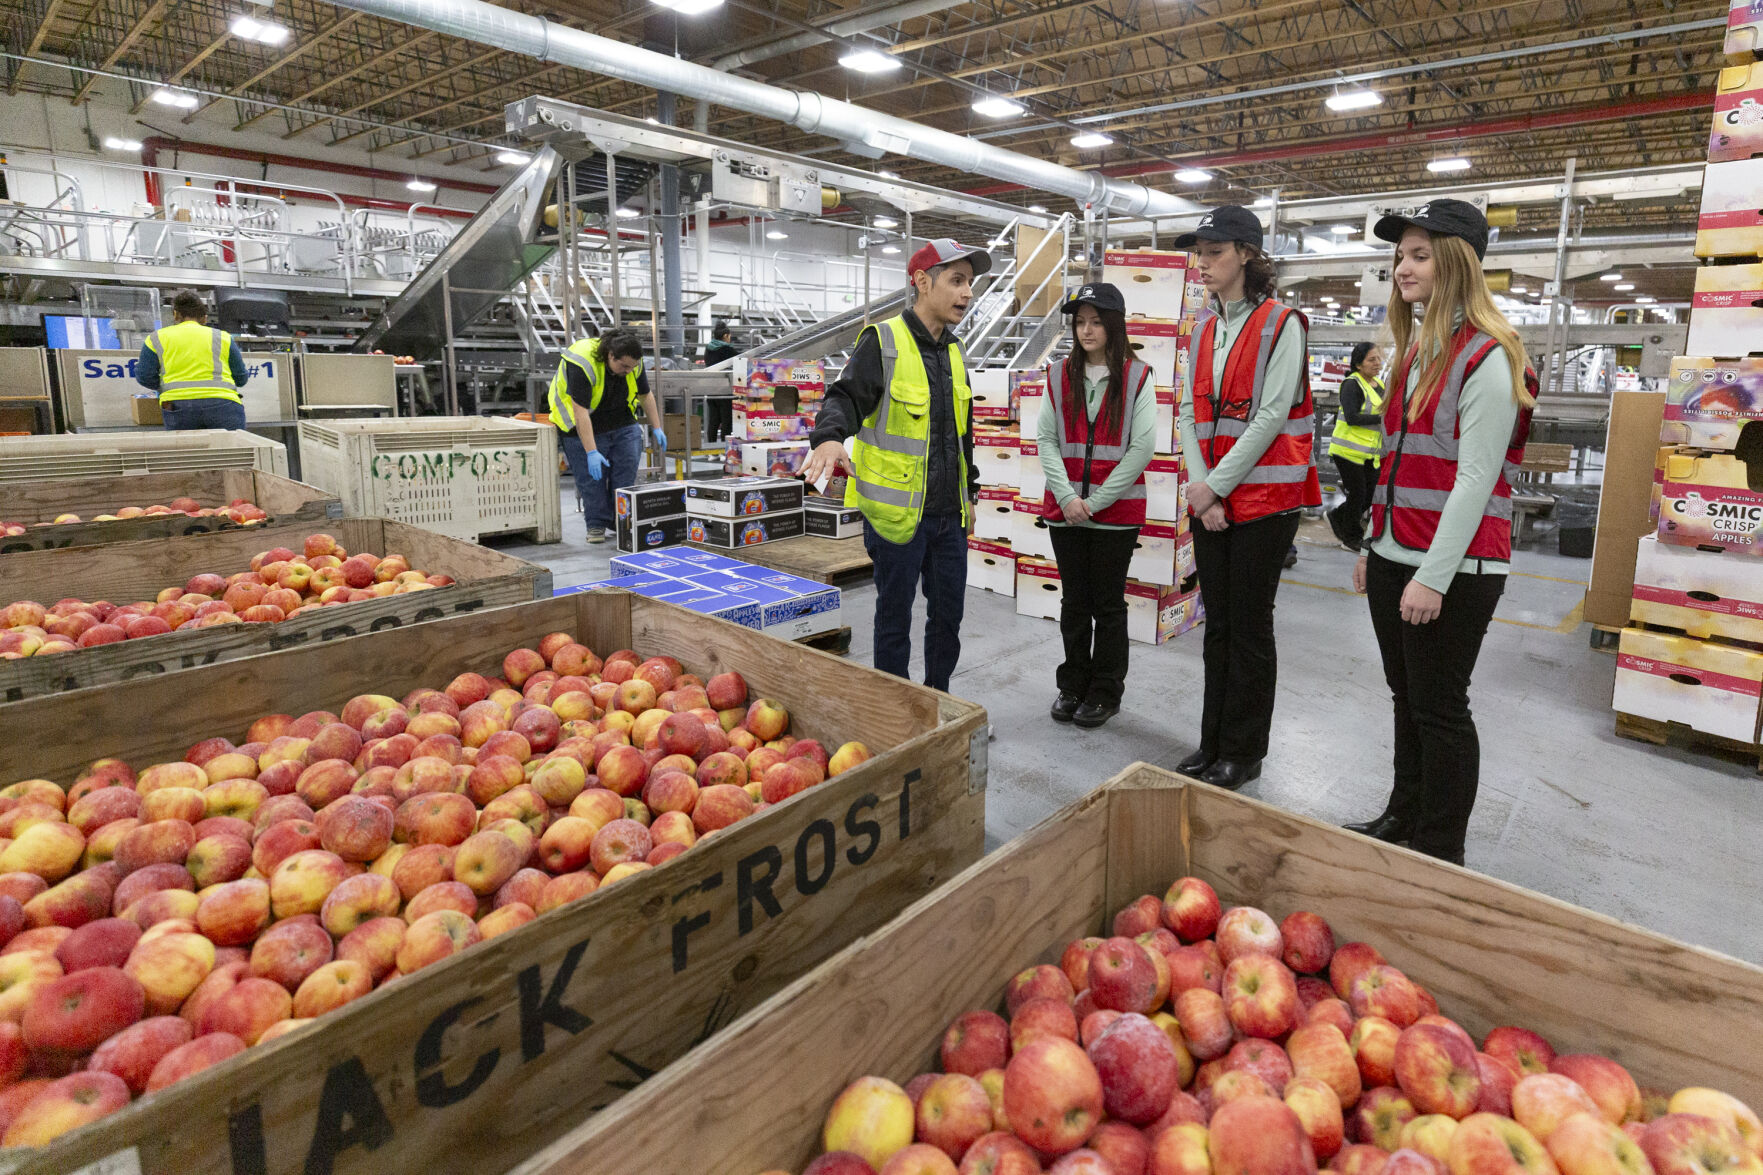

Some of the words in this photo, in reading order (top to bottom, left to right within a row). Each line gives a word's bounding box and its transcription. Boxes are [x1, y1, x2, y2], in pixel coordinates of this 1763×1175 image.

[1702, 293, 1734, 302] COSMIC
[371, 450, 536, 480] COMPOST
[1721, 494, 1756, 503] AMAZING
[1673, 499, 1762, 521] COSMIC
[1713, 519, 1756, 532] CRISP
[1711, 533, 1753, 545] APPLES
[1625, 656, 1654, 669] COSMIC
[671, 767, 922, 974] FROST
